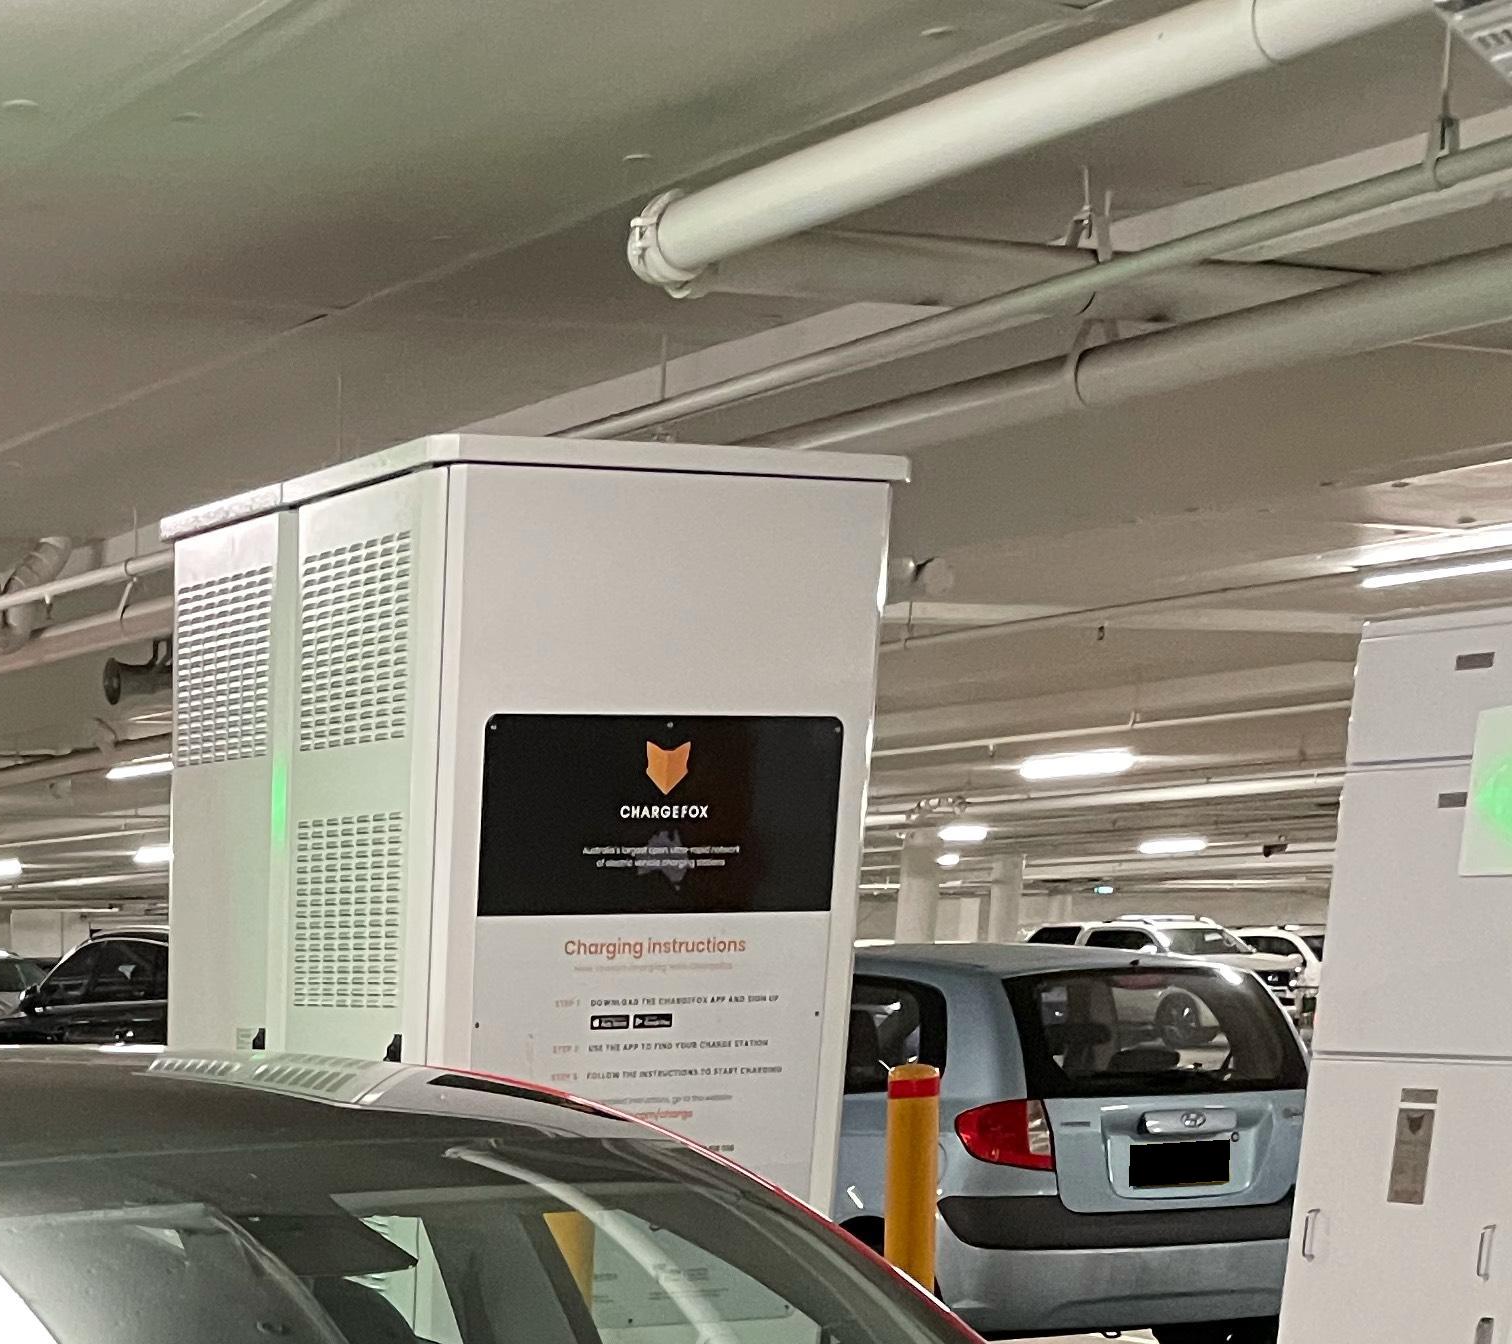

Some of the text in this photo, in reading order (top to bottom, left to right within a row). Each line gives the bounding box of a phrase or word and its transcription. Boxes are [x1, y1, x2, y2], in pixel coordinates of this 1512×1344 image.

[619, 805, 709, 819] CHARGEFOX
[564, 936, 746, 959] Charging instructions
